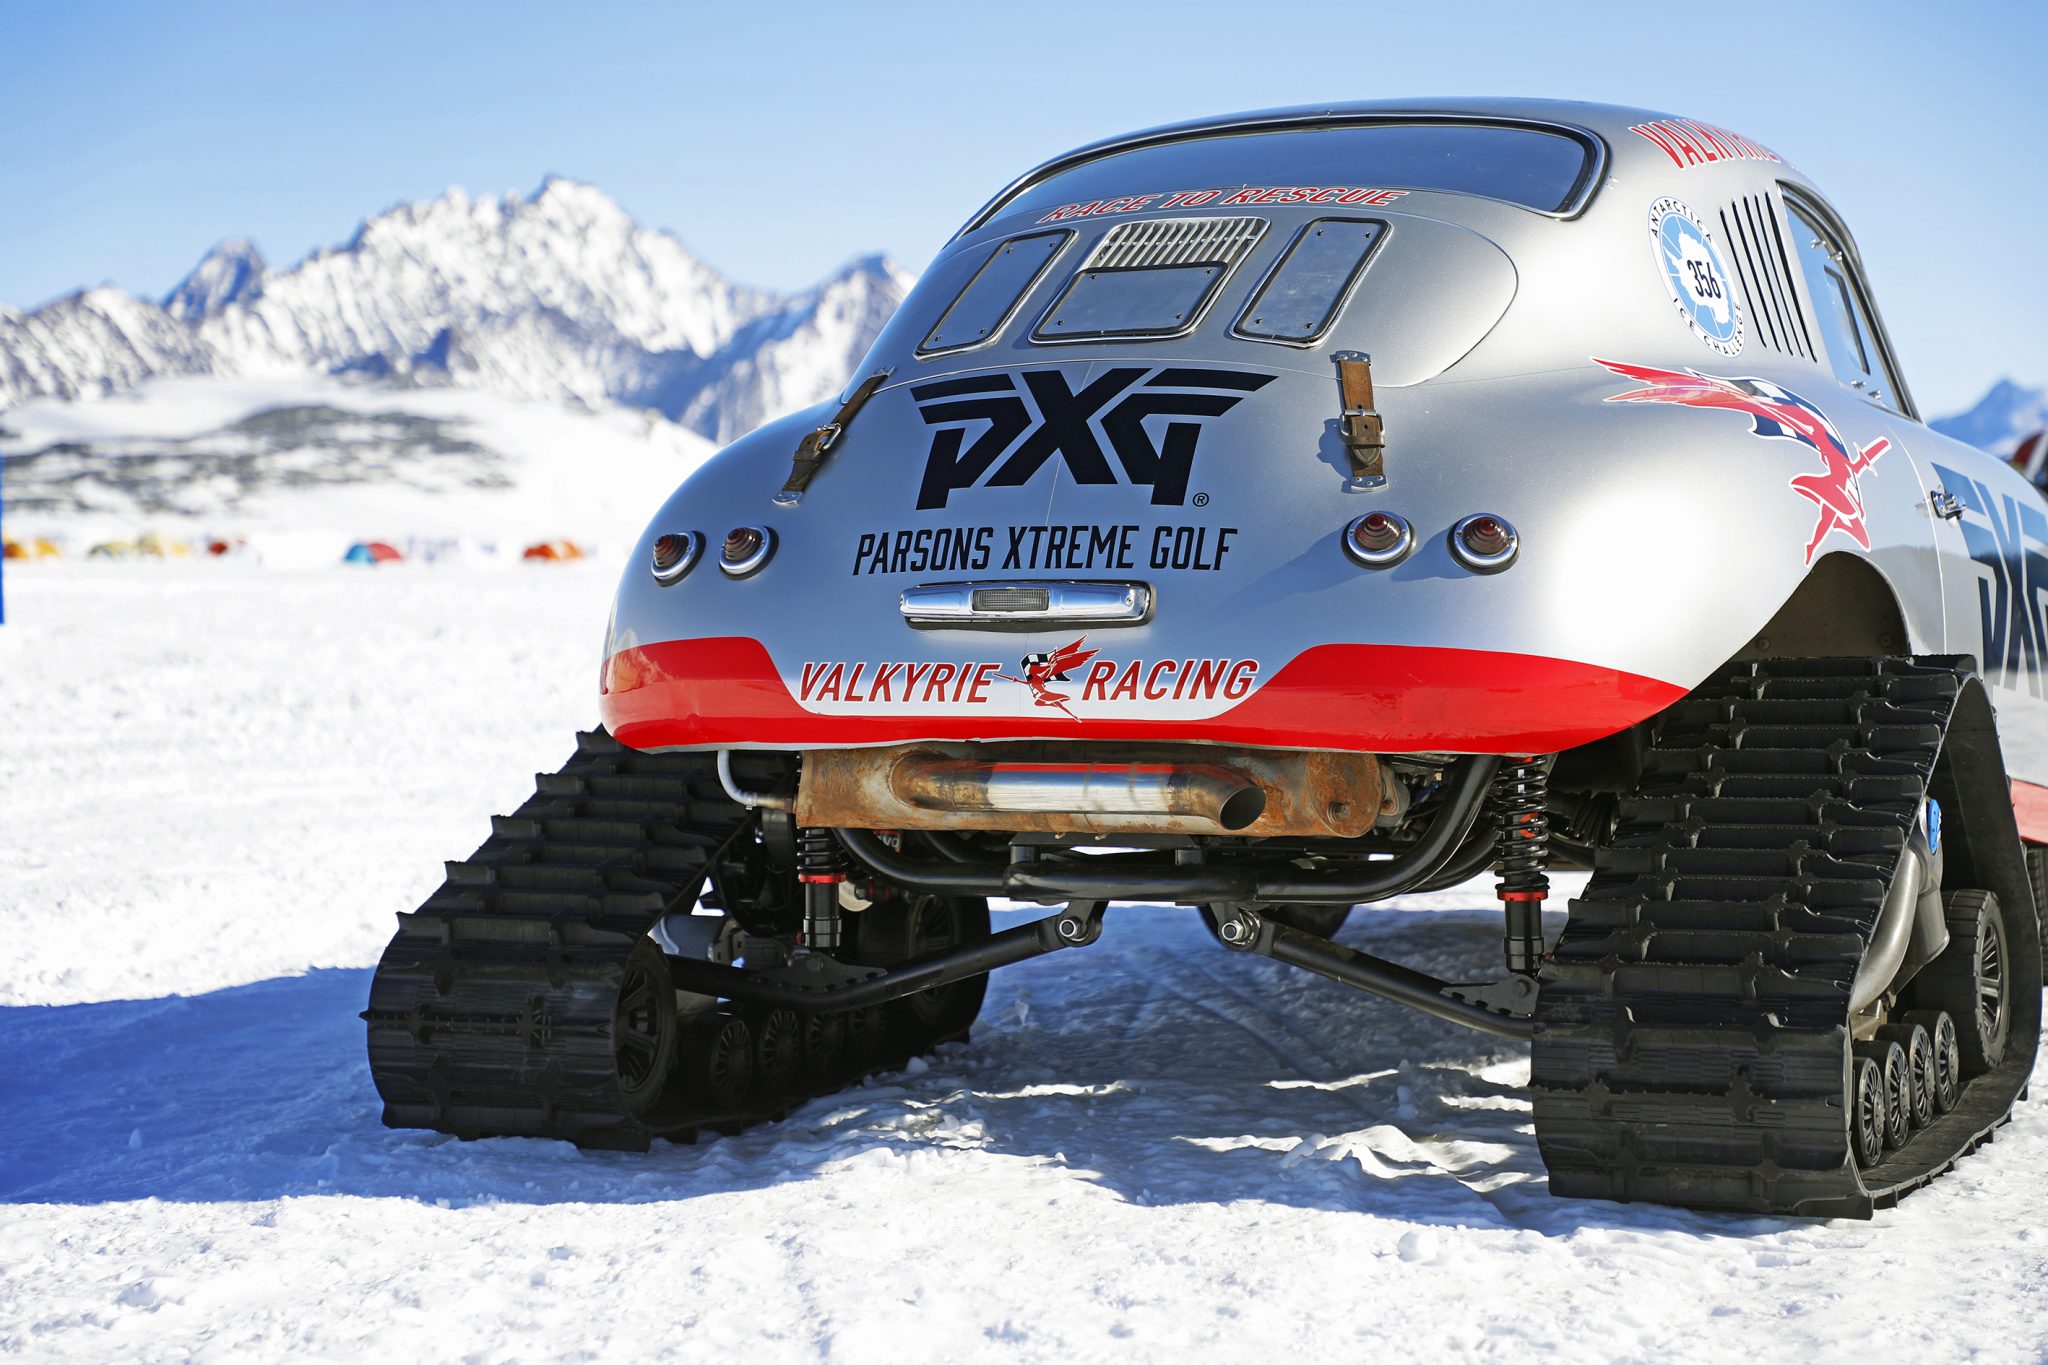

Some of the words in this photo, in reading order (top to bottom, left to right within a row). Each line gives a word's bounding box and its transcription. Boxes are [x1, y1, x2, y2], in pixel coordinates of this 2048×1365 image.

[1035, 194, 1163, 224] RACE
[1158, 189, 1225, 209] TO
[1219, 187, 1411, 207] RESCUE
[1651, 199, 1713, 244] ANTARCTICA
[1686, 259, 1722, 299] 356
[1673, 297, 1695, 332] ICE
[1703, 301, 1743, 356] CHALLENGE
[910, 368, 1279, 511] PXG
[852, 526, 994, 576] PARSONS
[1001, 525, 1140, 570] XTREME
[1149, 526, 1238, 571] GOLF
[799, 661, 1002, 704] VALKYRIE
[1081, 658, 1260, 703] RACING
